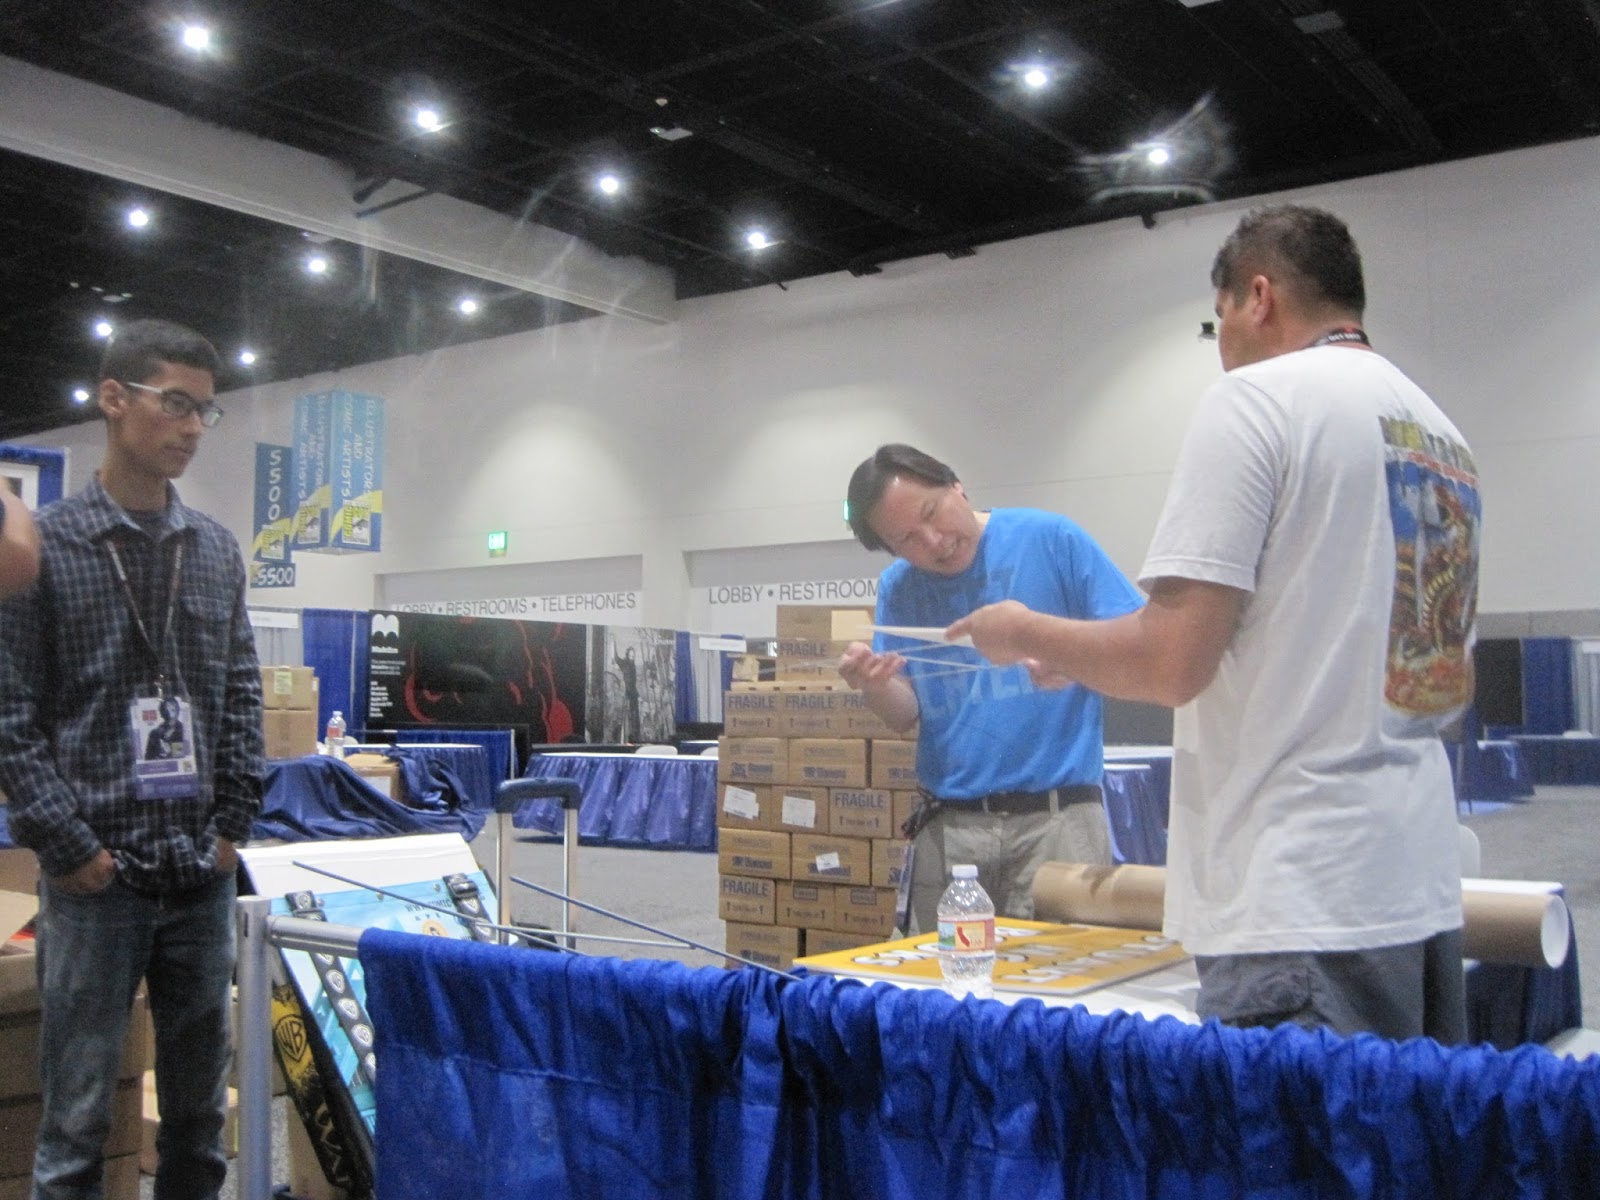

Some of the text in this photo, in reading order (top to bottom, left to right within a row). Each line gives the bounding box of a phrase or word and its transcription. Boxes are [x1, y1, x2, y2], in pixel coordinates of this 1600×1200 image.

[353, 433, 363, 459] AND
[341, 439, 353, 498] ARTISTS
[709, 585, 764, 604] LOBBY
[447, 598, 527, 616] RESTROOMS
[541, 592, 636, 613] TELEPHONES
[779, 641, 826, 657] FRAGILE
[728, 694, 774, 709] FRAGILE
[785, 694, 835, 710] FRAGILE
[834, 791, 885, 808] FRAGILE
[722, 879, 768, 897] FRAGILE
